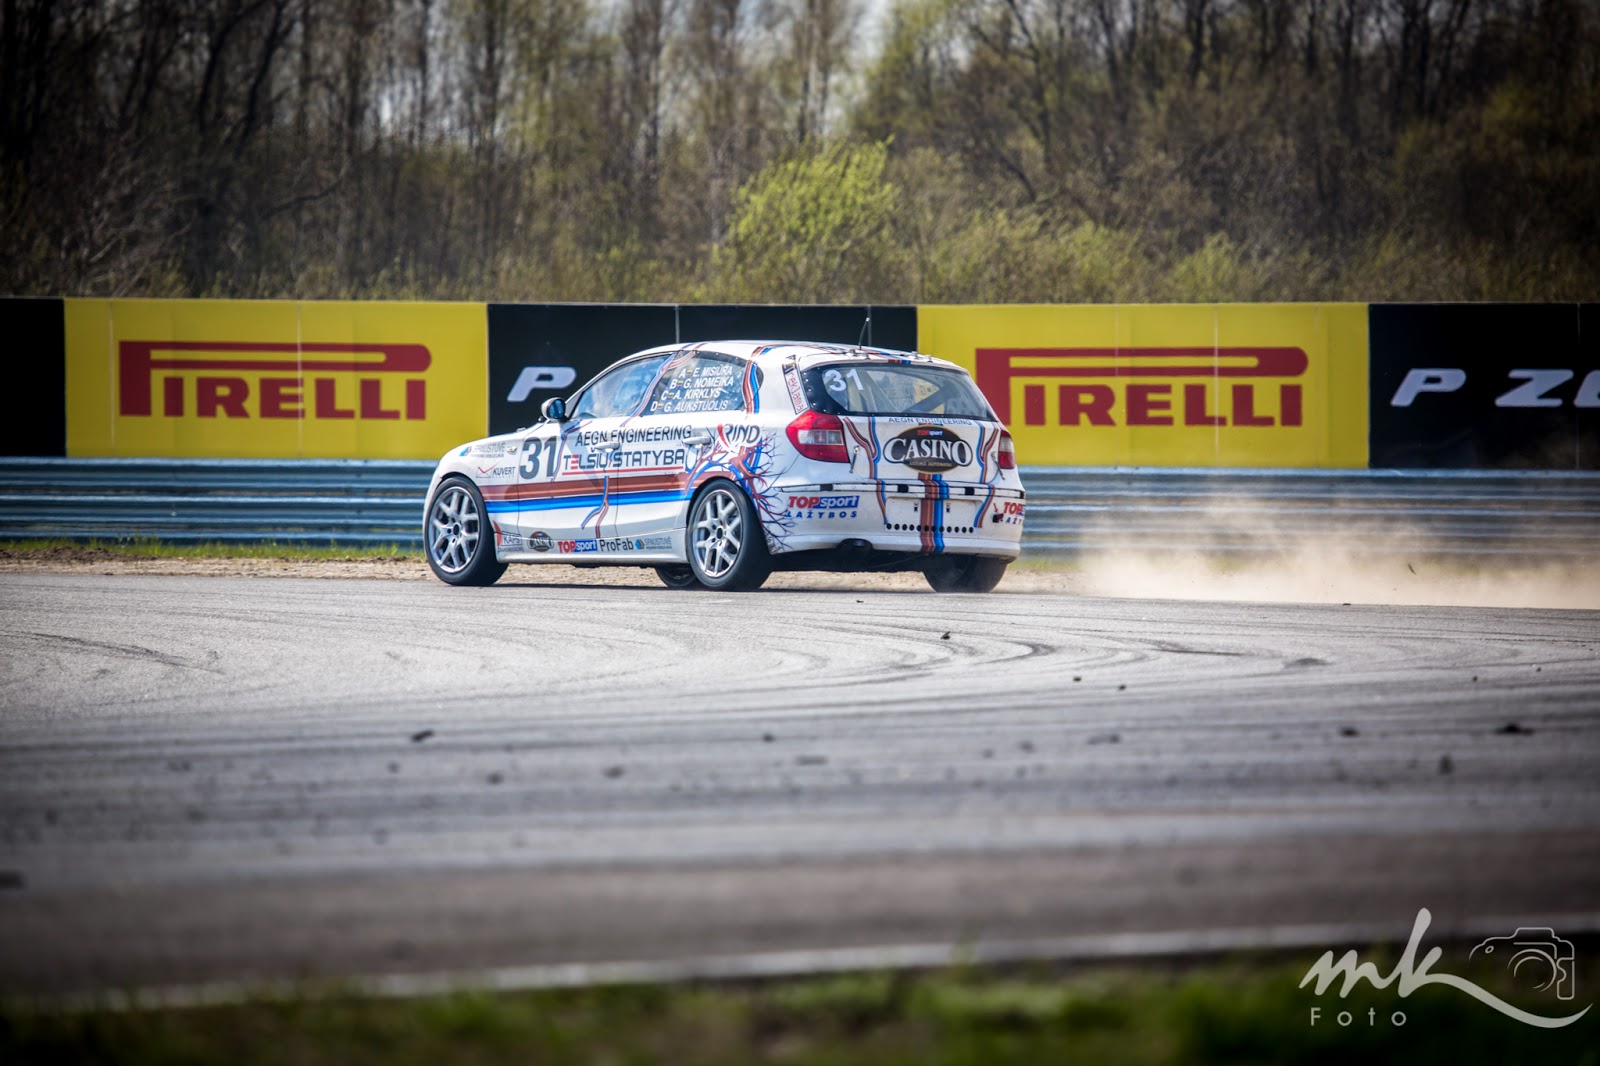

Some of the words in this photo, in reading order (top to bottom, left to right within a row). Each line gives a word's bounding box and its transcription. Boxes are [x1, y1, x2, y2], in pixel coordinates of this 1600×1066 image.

[119, 340, 432, 420] PIRELLI
[507, 365, 576, 402] P
[684, 387, 720, 399] KIRKLYS
[694, 376, 734, 388] NOMEIKA
[823, 368, 864, 392] 31
[975, 346, 1308, 426] PIRELLI
[1390, 368, 1467, 407] P
[611, 425, 692, 443] ENGINEERING
[520, 436, 557, 479] 31
[883, 438, 973, 467] CASINO
[599, 538, 634, 552] ProFab
